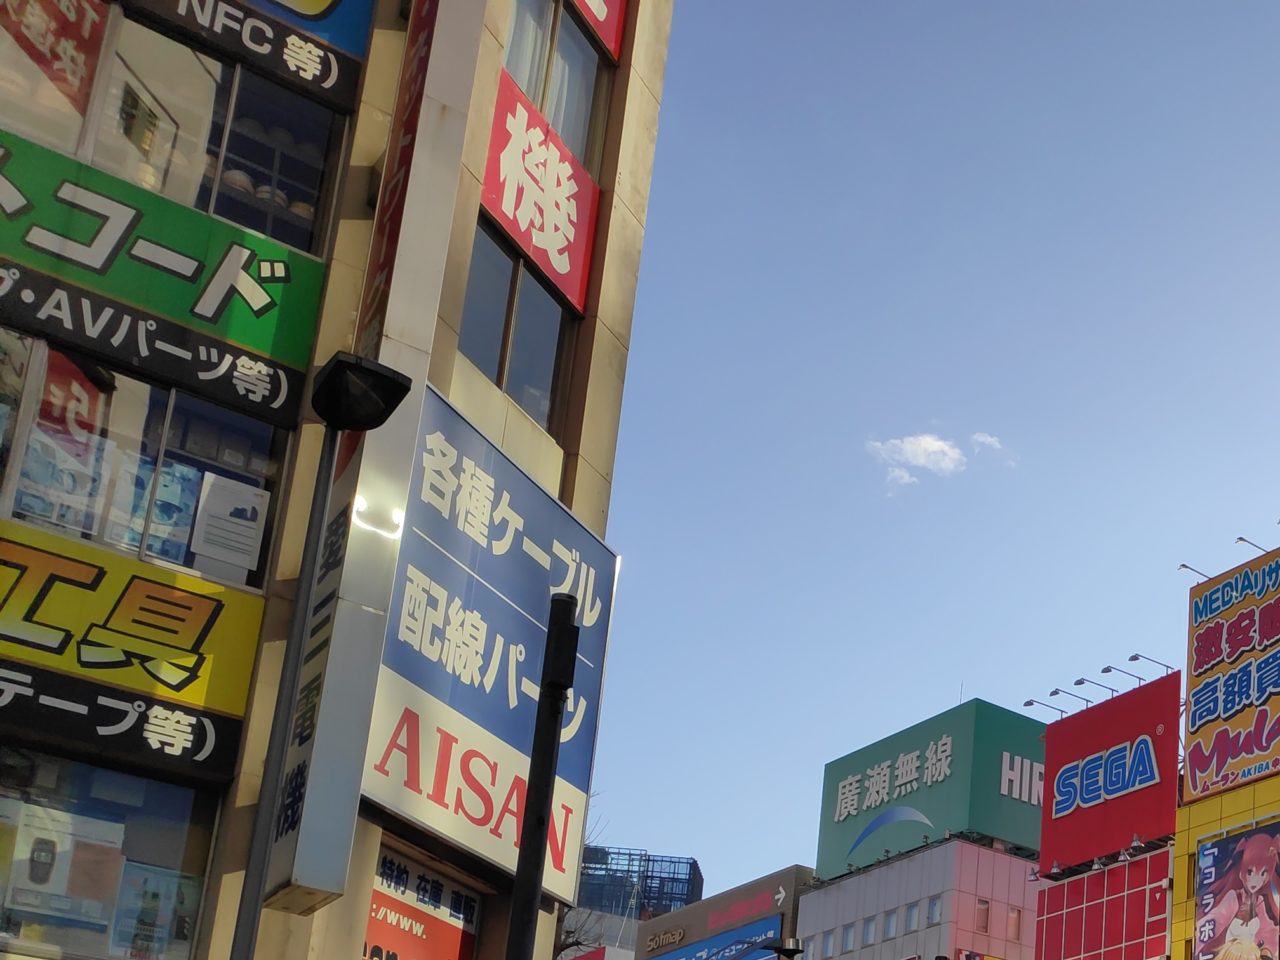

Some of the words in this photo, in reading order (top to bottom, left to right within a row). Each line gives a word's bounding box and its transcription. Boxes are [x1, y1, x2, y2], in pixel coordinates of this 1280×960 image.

[502, 102, 577, 275] 機
[418, 431, 603, 628] 各種ケーブル
[0, 545, 222, 691] 工具
[373, 706, 575, 875] AISAN
[1052, 734, 1160, 820] SEGA
[1240, 761, 1270, 780] AKIBA
[646, 928, 686, 951] Sofmap
